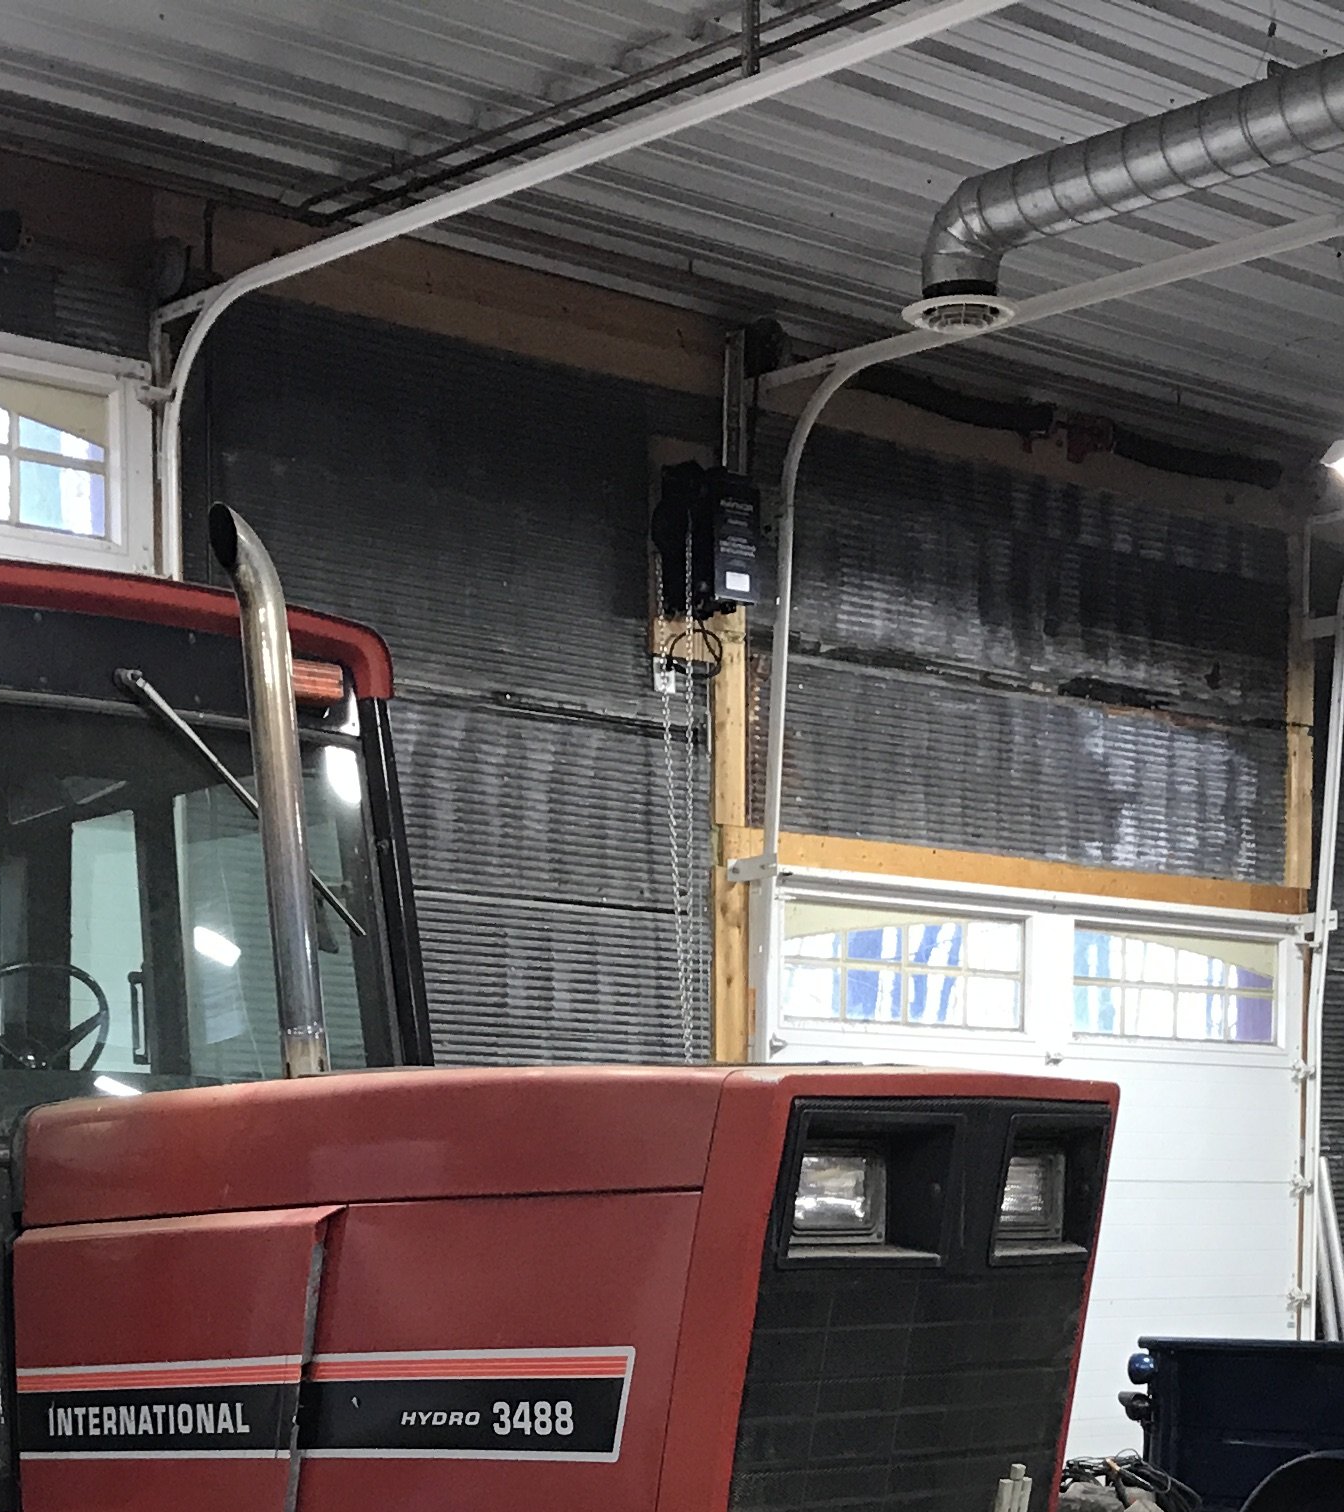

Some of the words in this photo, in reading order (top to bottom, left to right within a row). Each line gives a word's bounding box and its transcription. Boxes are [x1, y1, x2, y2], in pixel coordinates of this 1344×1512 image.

[48, 1401, 250, 1437] INTERNATIONAL
[400, 1411, 481, 1426] HYDRO
[492, 1401, 574, 1436] 3488
